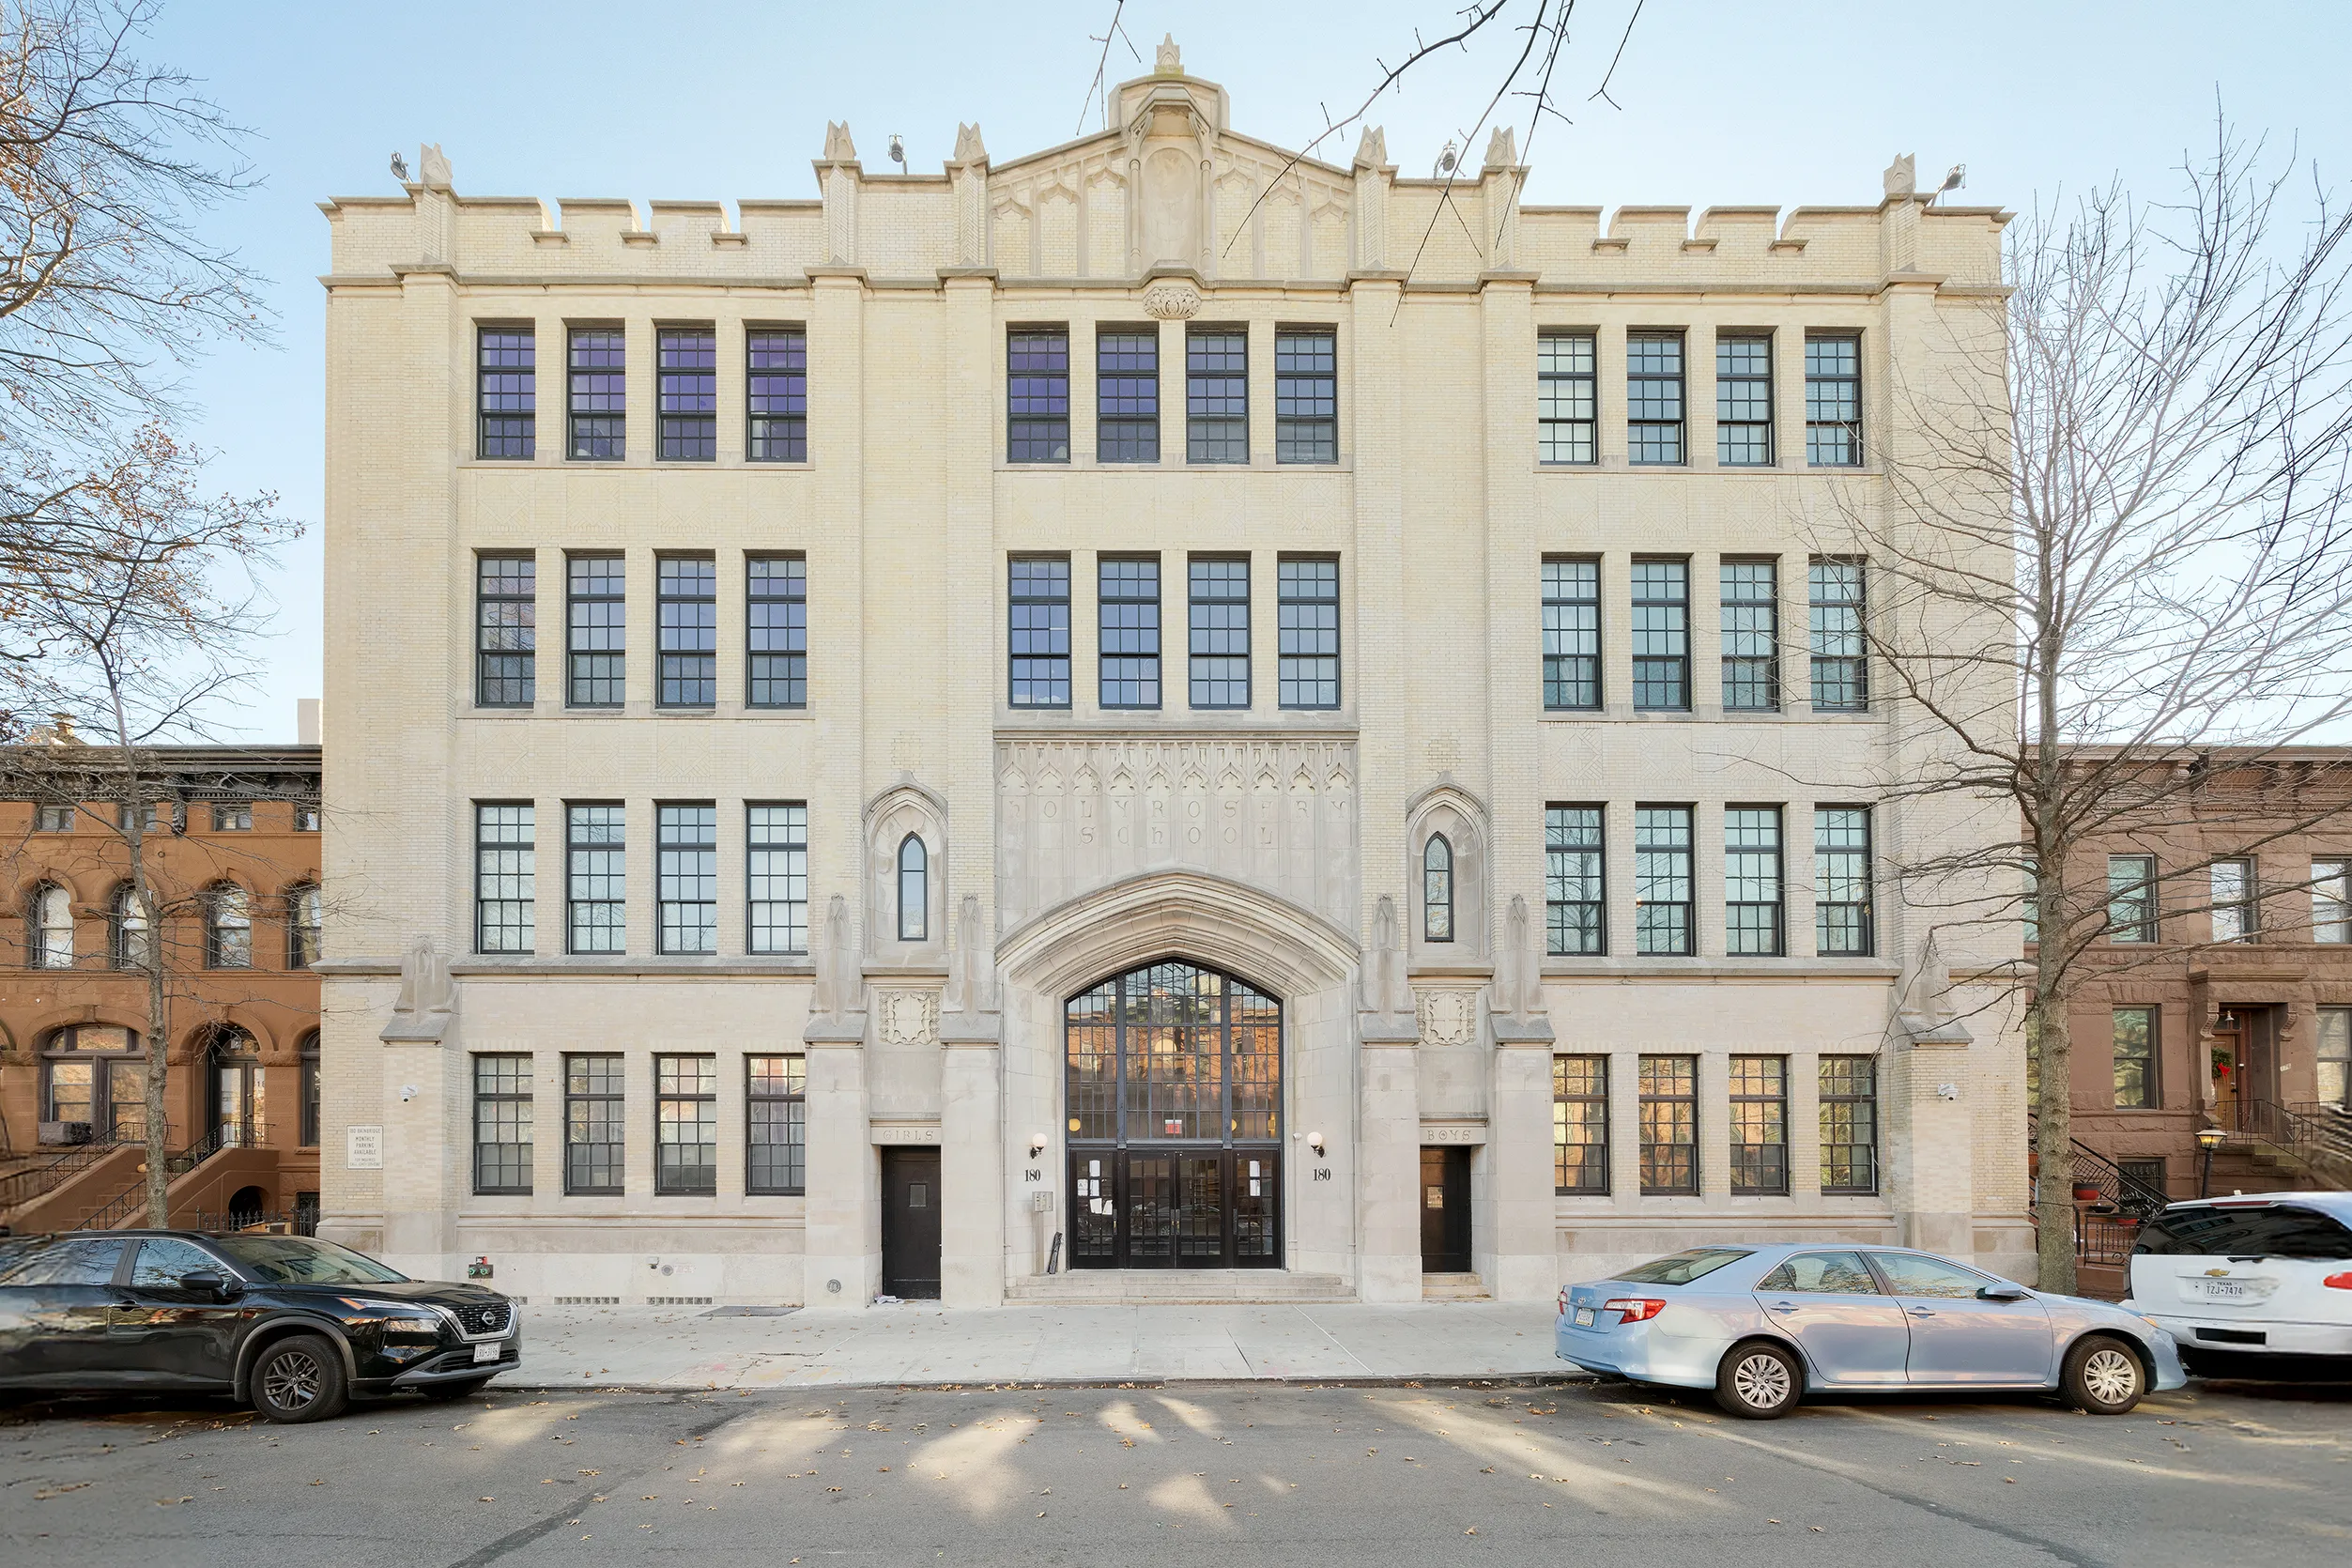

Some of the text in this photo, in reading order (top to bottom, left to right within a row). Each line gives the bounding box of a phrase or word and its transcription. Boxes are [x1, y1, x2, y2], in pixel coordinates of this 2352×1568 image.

[883, 1130, 934, 1142] GIRLS
[1426, 1130, 1471, 1142] BOYS
[1024, 1168, 1041, 1182] 180
[1313, 1168, 1331, 1182] 180
